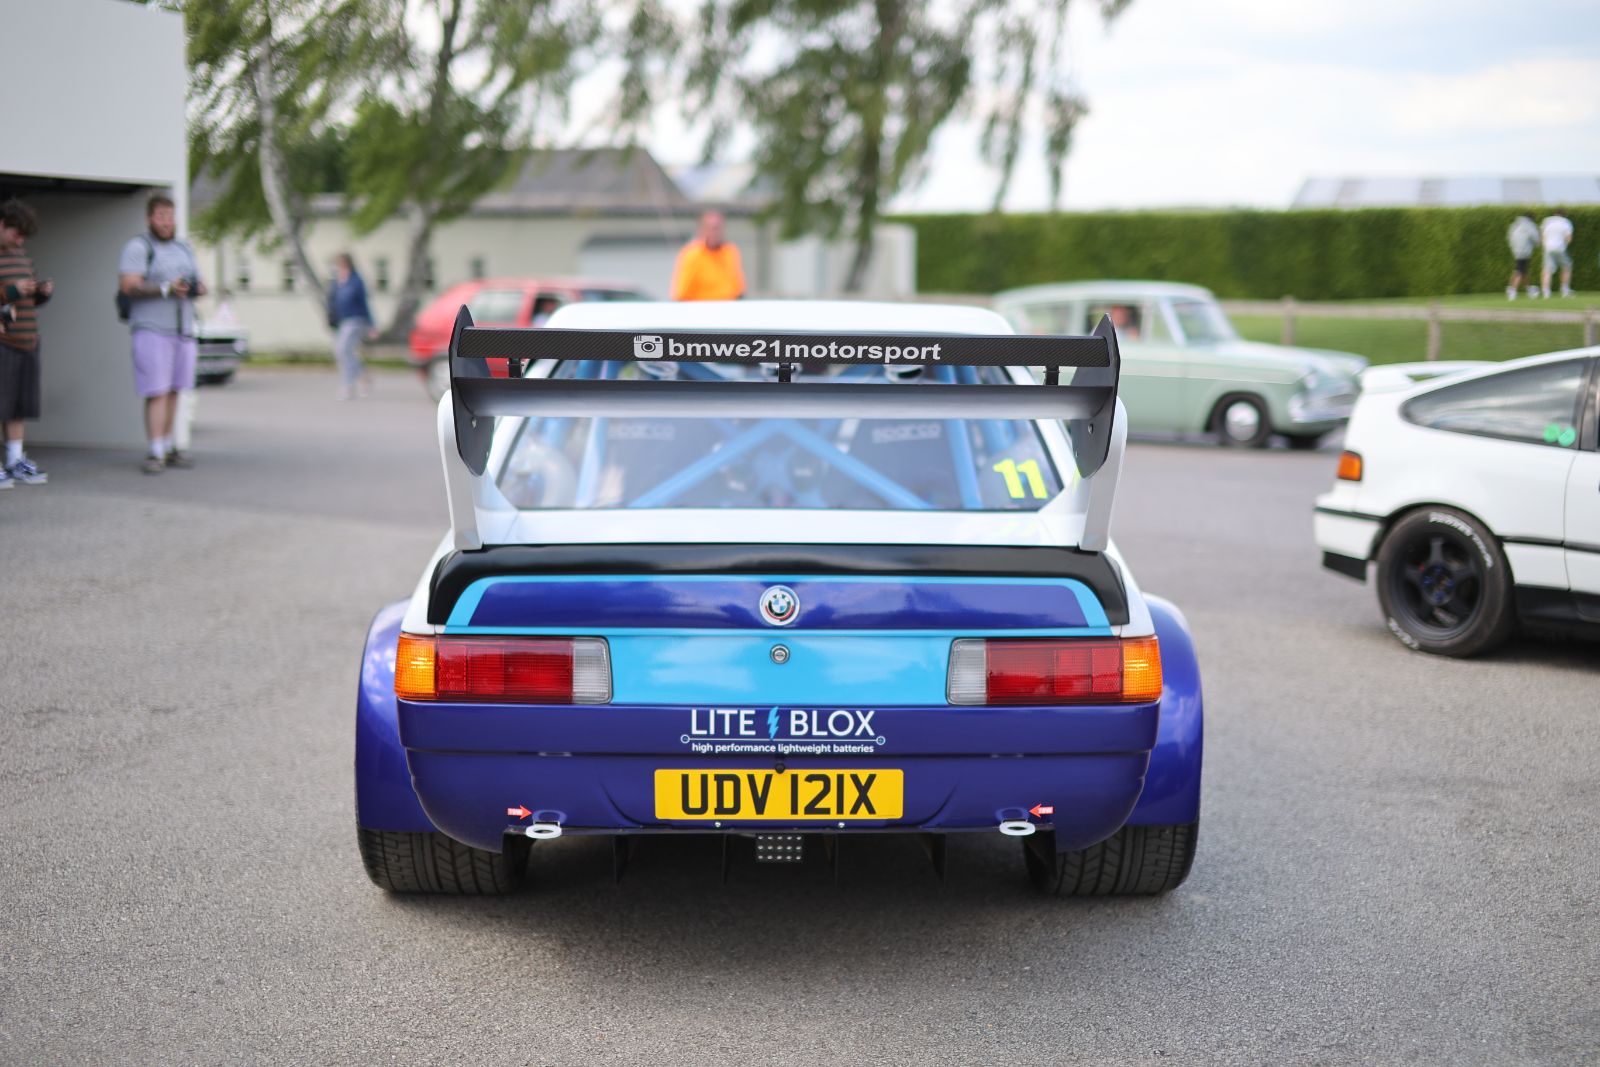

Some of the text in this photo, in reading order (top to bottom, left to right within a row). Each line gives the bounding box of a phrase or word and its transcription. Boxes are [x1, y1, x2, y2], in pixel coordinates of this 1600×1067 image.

[668, 338, 942, 364] bmwe21motorsport
[993, 458, 1048, 499] 11
[691, 709, 876, 737] LITE BLOX
[692, 743, 875, 754] high performance lightweight batteries
[681, 773, 877, 816] UDV 121X
